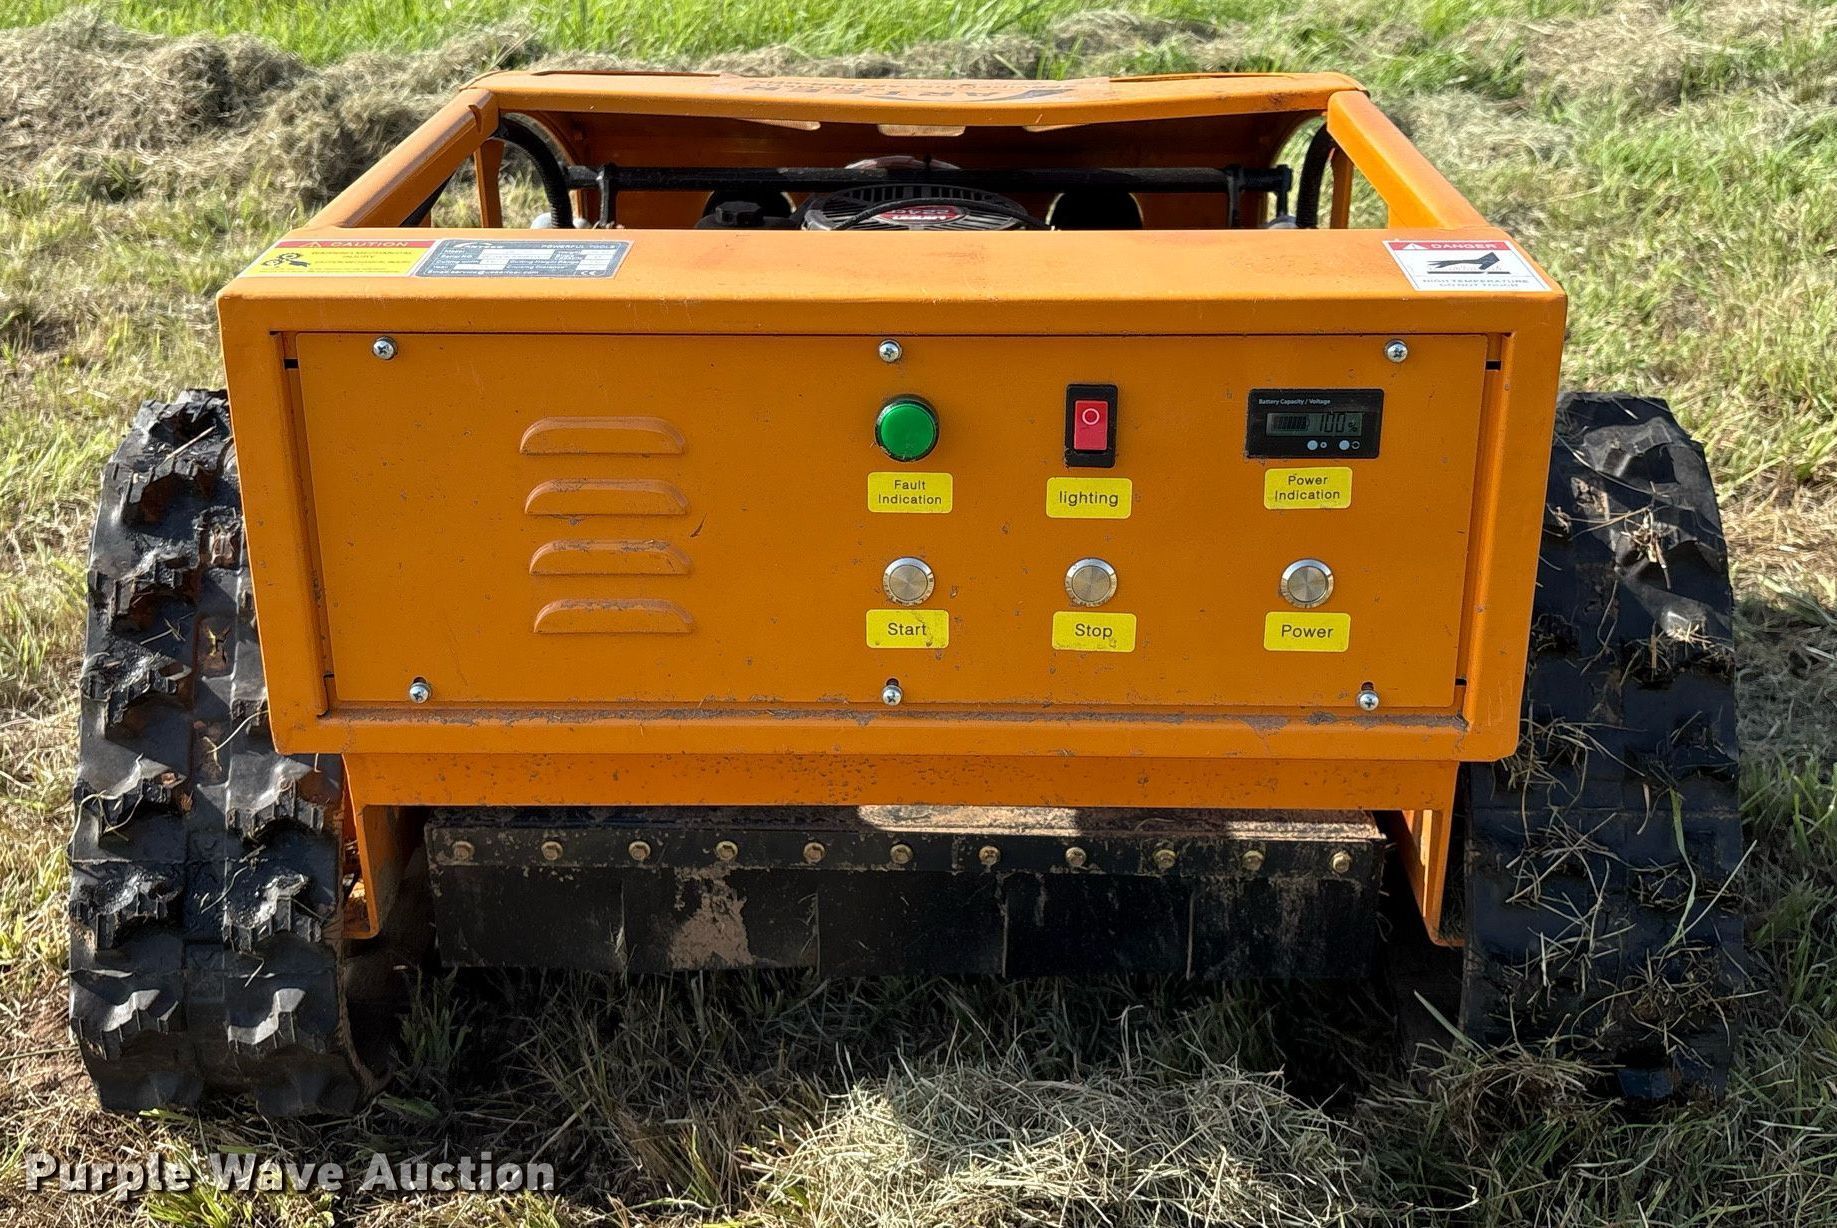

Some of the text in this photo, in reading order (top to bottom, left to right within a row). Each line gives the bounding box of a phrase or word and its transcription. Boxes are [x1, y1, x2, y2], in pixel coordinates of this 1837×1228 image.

[894, 479, 926, 490] Fault
[1288, 475, 1328, 486] Power
[878, 494, 942, 505] Indication
[1059, 490, 1119, 508] lighting
[1275, 489, 1340, 501] Indication
[887, 622, 928, 637] Start
[1074, 623, 1113, 639] Stop
[1281, 624, 1334, 638] Power
